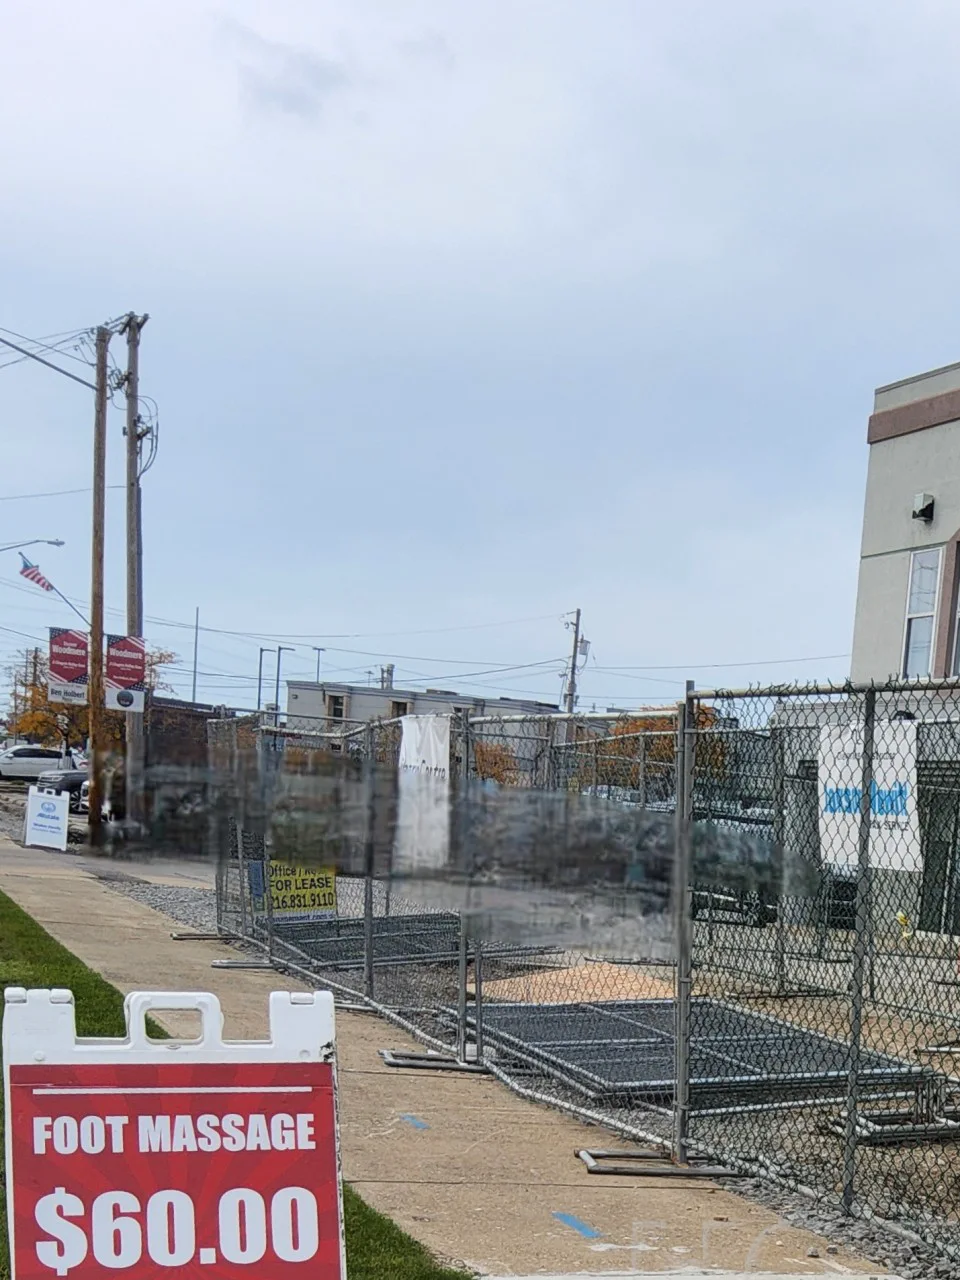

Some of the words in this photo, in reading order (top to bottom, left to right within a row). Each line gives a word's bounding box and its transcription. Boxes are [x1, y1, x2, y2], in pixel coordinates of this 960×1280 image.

[294, 876, 332, 891] LEASE
[32, 1115, 129, 1155] FOOT
[138, 1112, 316, 1154] MASSAGE
[34, 1186, 319, 1277] $60.00
